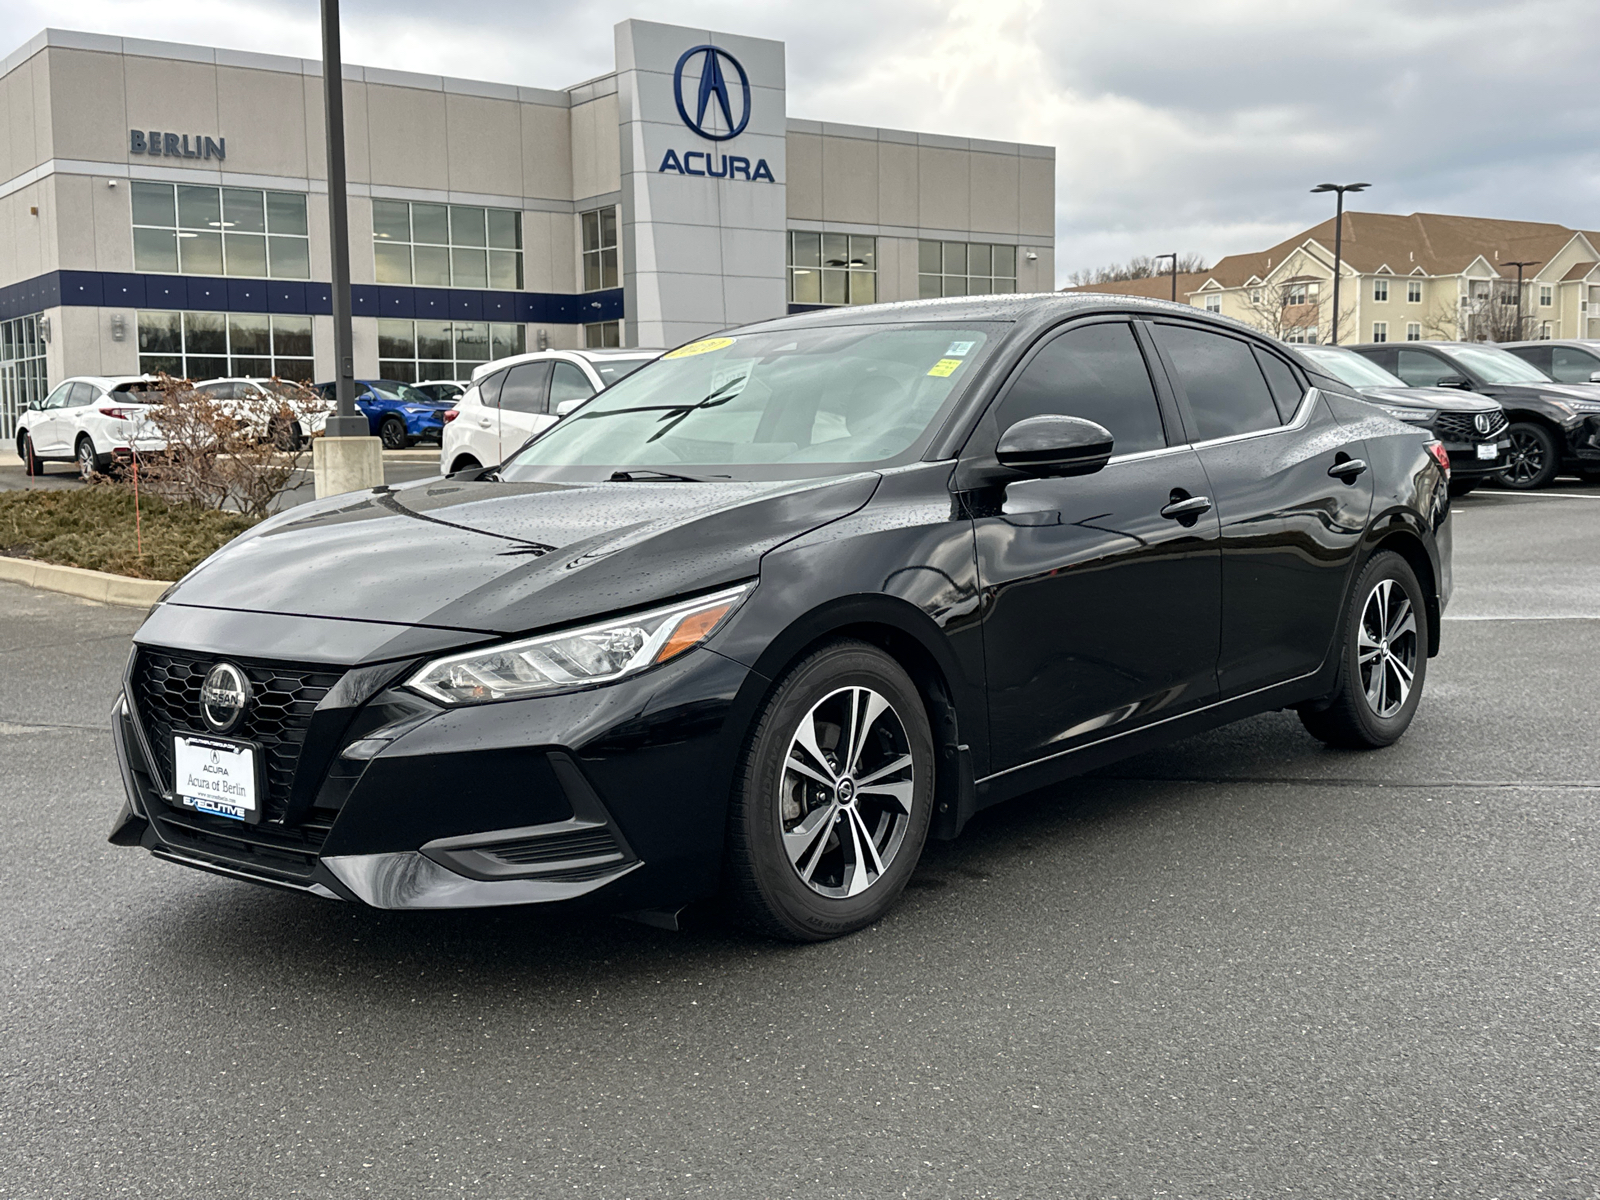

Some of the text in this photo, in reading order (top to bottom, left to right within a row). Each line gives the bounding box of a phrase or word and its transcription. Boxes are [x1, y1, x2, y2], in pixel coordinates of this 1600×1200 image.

[130, 129, 226, 160] BERLIN
[658, 148, 776, 183] ACURA
[203, 764, 229, 776] ACURA
[187, 774, 246, 797] Acura of Berlin
[183, 796, 245, 817] EXECUTIVE
